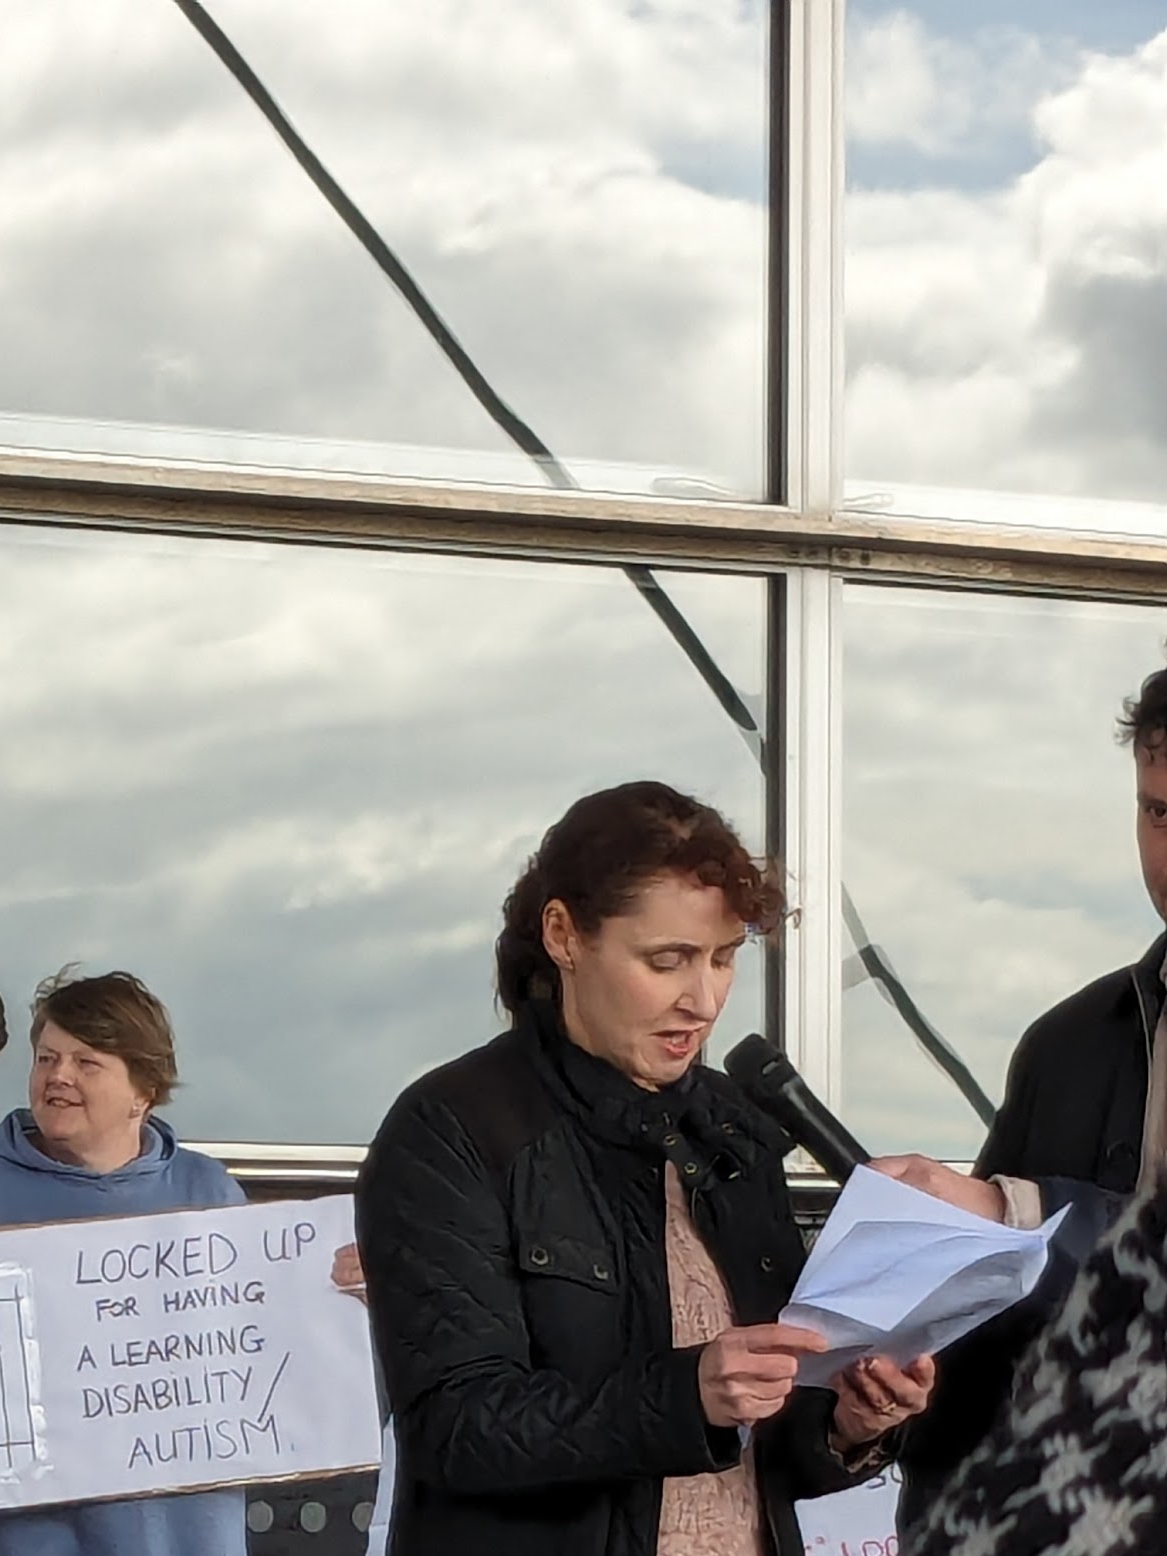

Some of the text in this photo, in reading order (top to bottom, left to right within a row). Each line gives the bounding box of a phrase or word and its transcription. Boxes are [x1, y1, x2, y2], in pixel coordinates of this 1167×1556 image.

[76, 1222, 316, 1285] LOCKED UP
[96, 1280, 266, 1322] FOR HAVING
[77, 1325, 266, 1373] A LEARNING
